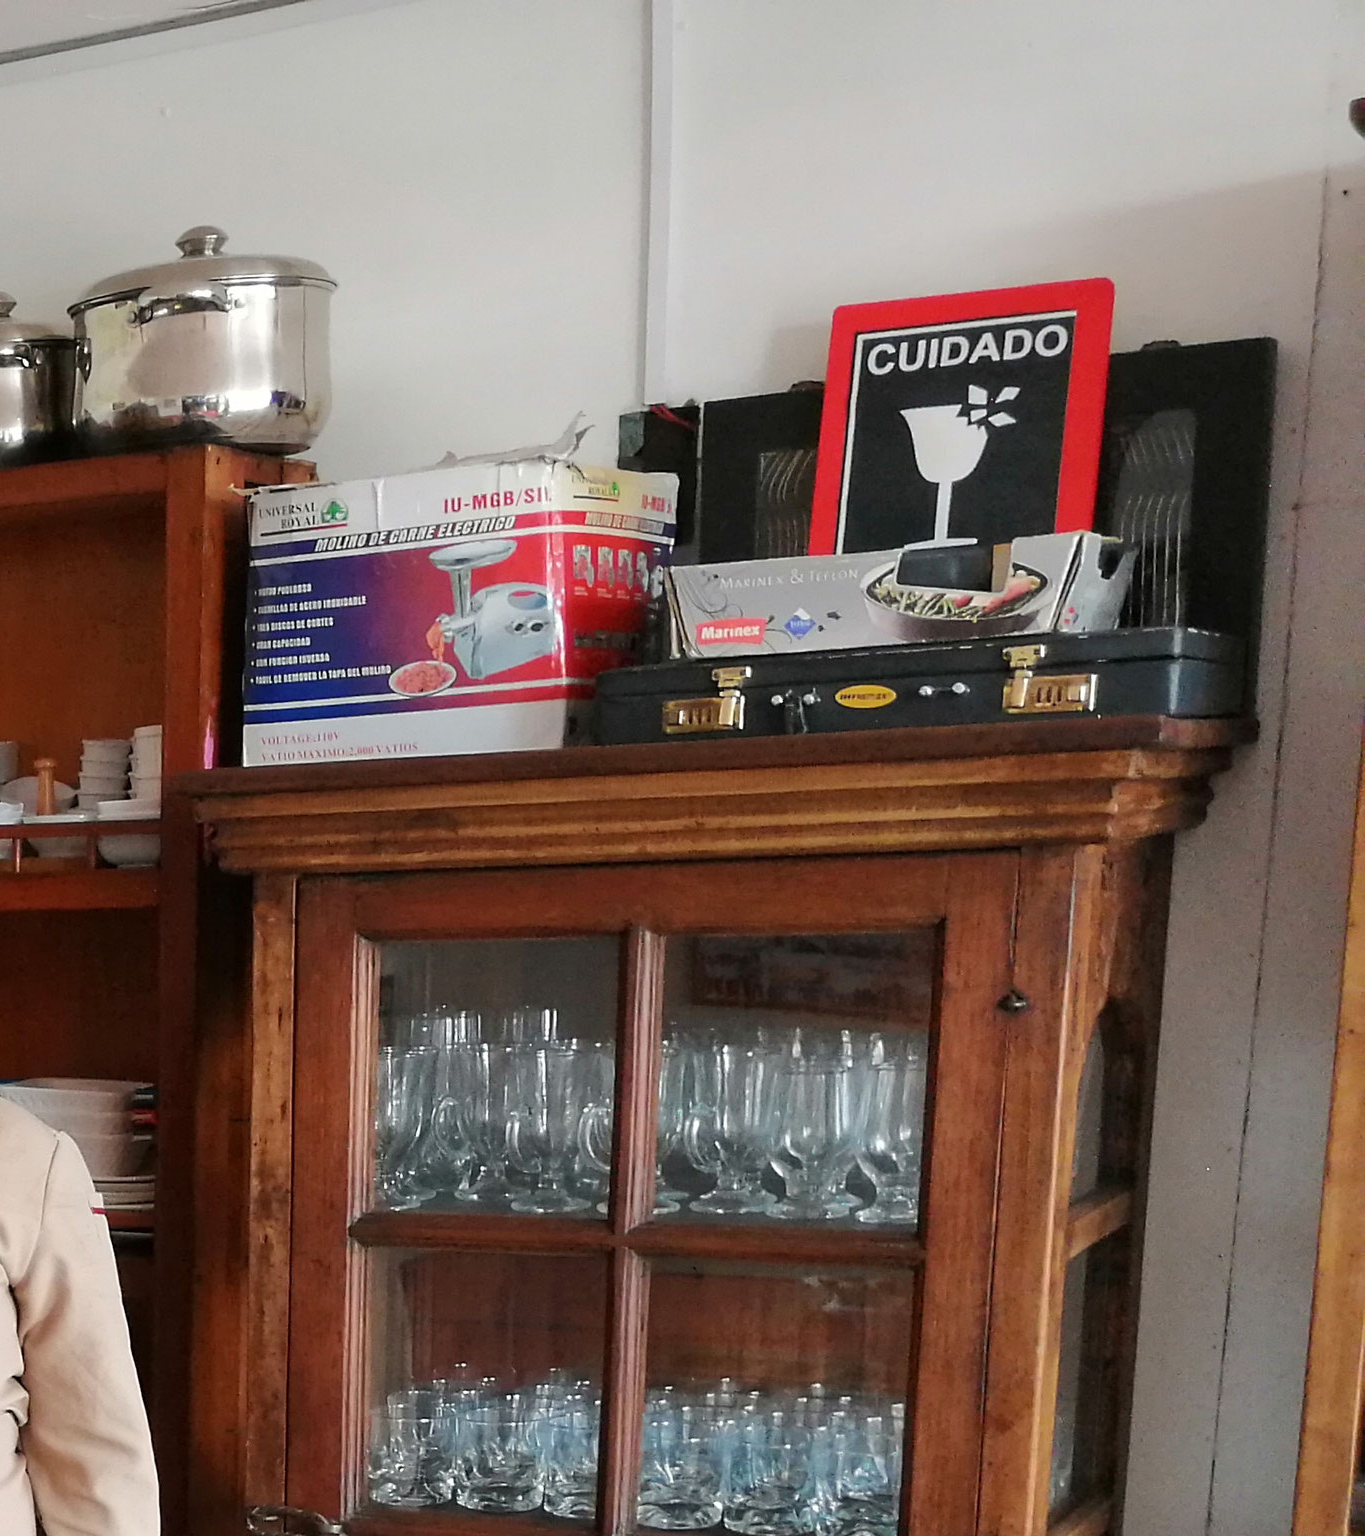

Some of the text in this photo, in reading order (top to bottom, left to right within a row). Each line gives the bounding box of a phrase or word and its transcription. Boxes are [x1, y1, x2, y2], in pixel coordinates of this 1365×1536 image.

[867, 325, 1068, 375] CUIDADO
[258, 502, 318, 518] UNIVERSAL
[281, 515, 319, 529] ROYAL
[314, 515, 516, 552] MOLINO DE CARNE ELECTRICO
[790, 568, 804, 584] &
[701, 624, 760, 640] Marinex
